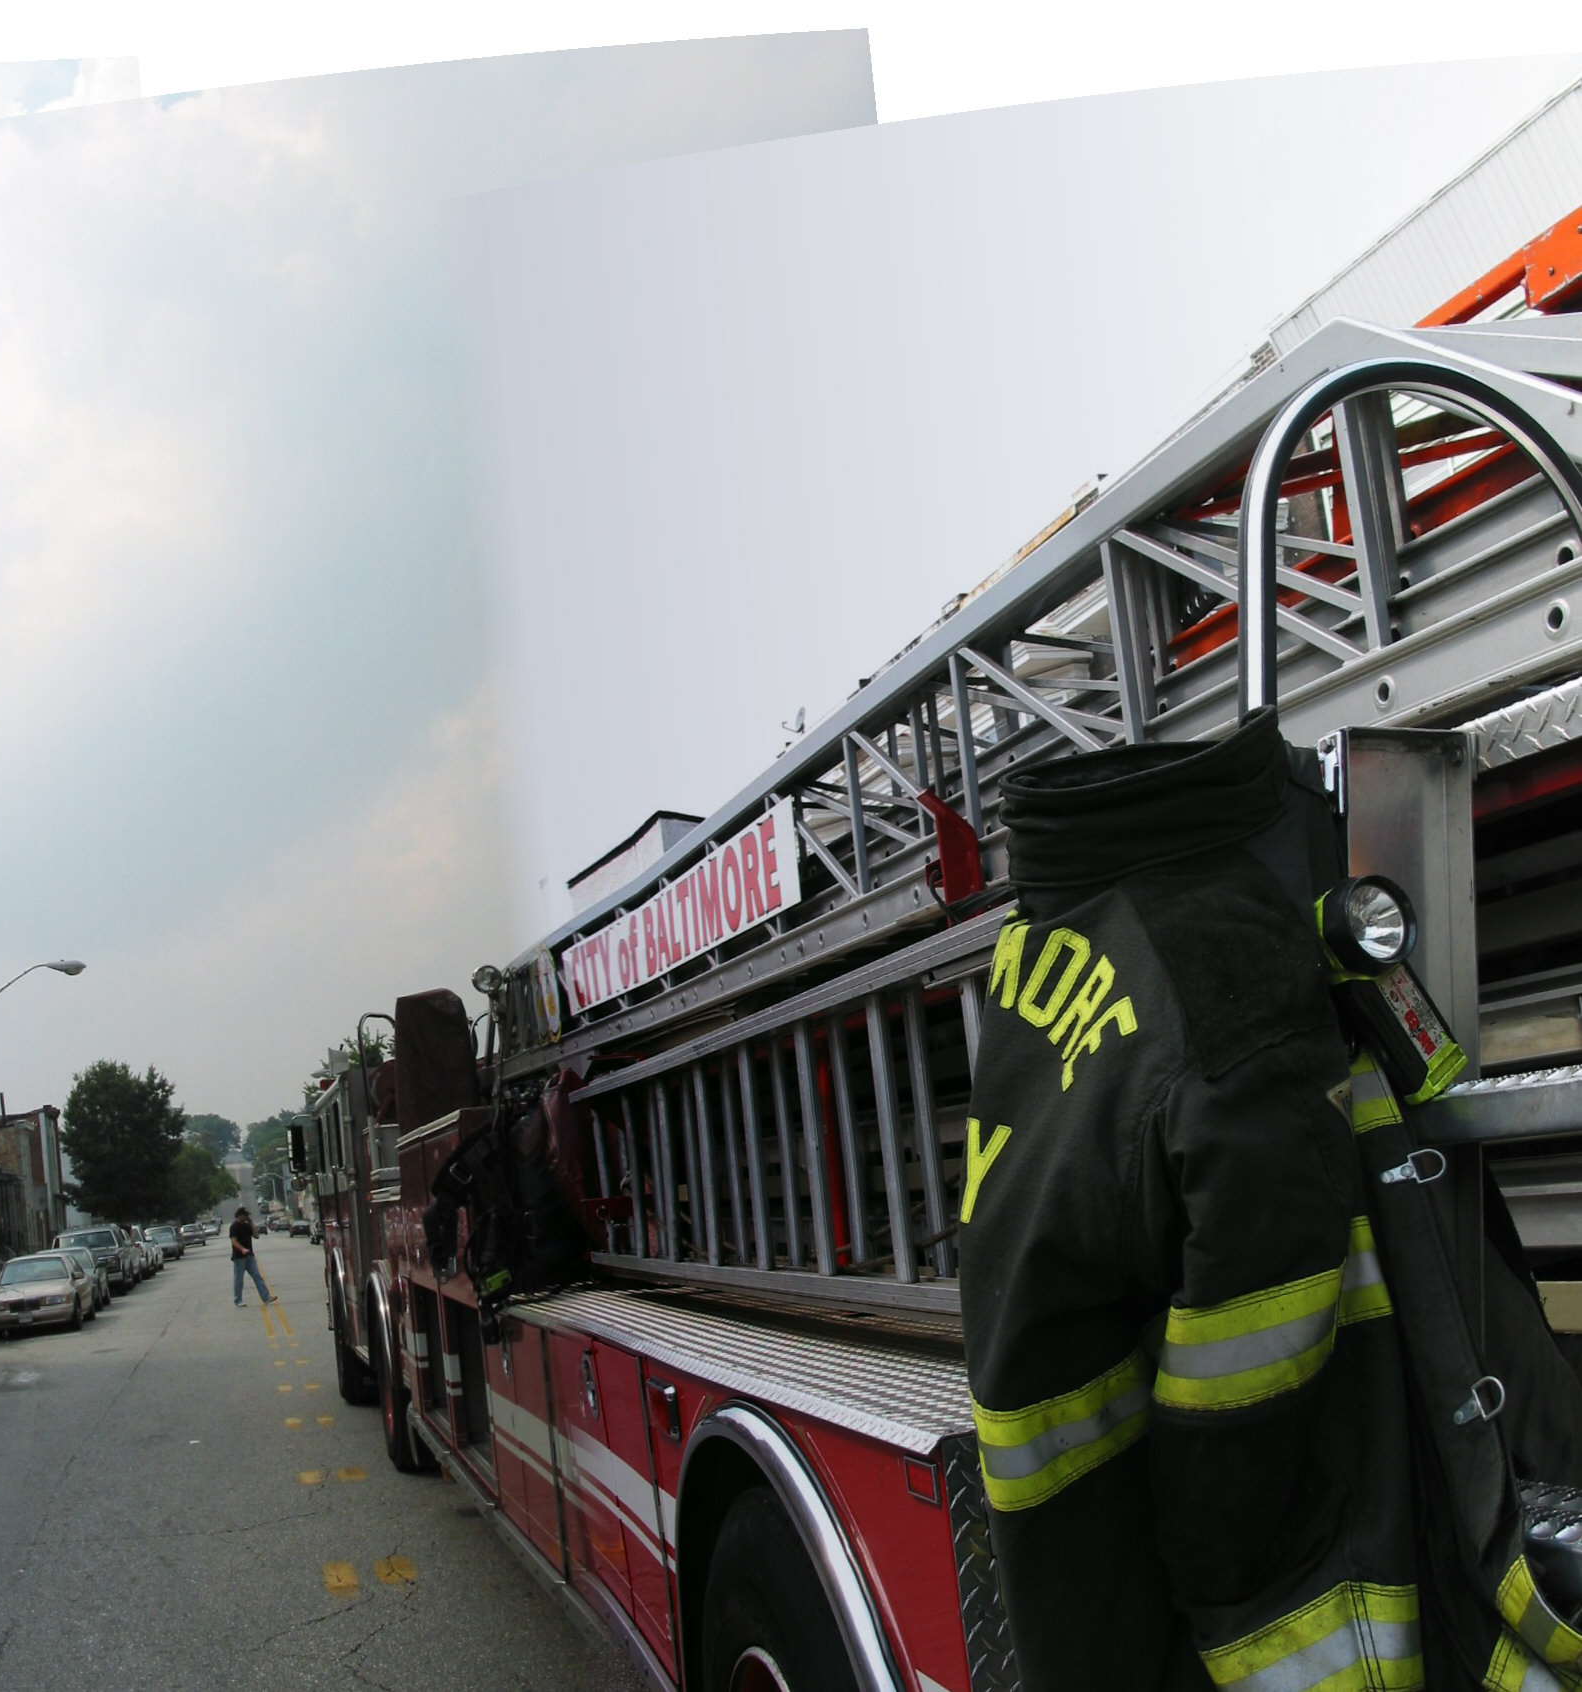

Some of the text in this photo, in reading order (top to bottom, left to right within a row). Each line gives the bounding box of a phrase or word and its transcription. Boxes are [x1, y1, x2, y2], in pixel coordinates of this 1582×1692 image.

[572, 814, 782, 1008] CITY of BALTIMORE
